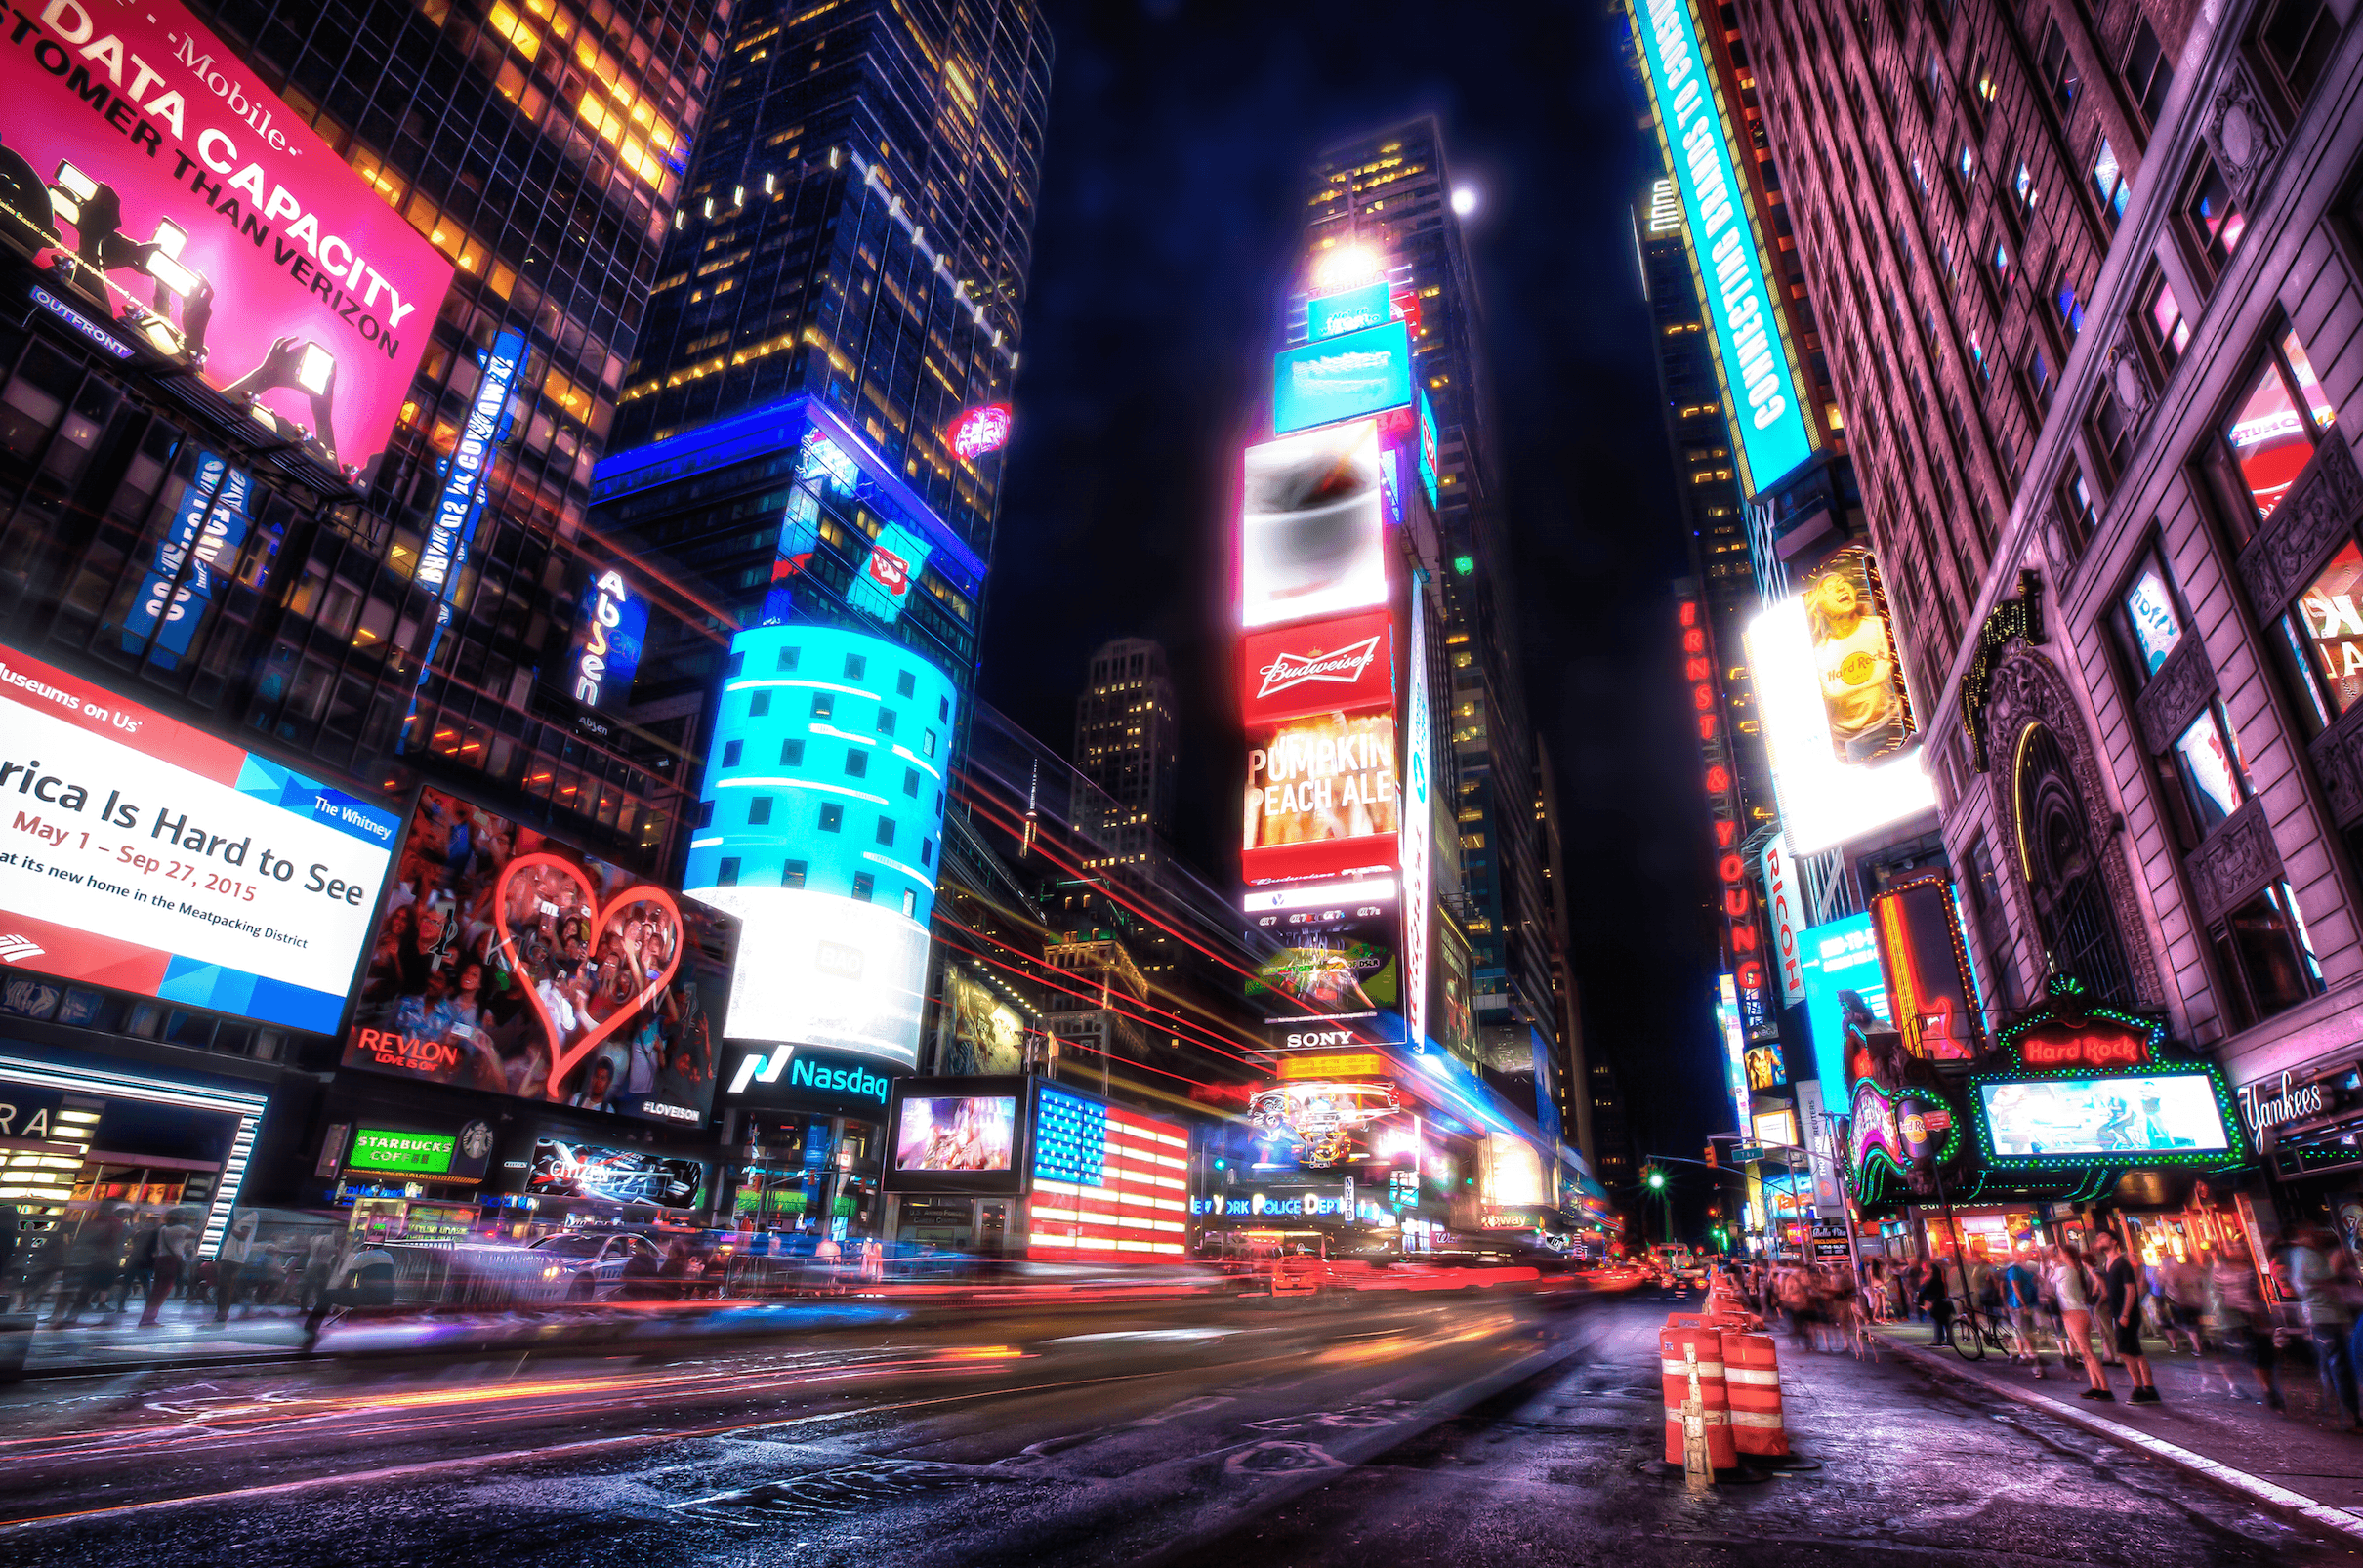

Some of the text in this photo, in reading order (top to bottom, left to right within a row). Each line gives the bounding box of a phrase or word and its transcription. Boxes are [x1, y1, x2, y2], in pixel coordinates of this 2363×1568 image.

[1673, 79, 1703, 131] TO
[40, 0, 416, 329] DATA CAPACITY
[1682, 115, 1734, 240] BRANDS
[175, 148, 270, 248] THAN
[274, 235, 400, 360] VERIZON
[36, 290, 130, 356] OUTFRONT
[1712, 226, 1786, 431] CONNECTING
[575, 570, 627, 707] Absen
[1260, 652, 1373, 683] Budweiser
[1679, 602, 1717, 740] ERNST
[1827, 660, 1855, 682] Hard
[84, 702, 109, 722] on
[112, 711, 139, 734] Us
[1248, 732, 1392, 785] PUMPKIN
[314, 795, 393, 841] The Whitney
[1246, 769, 1393, 817] PEACH ALE
[12, 810, 70, 847] May
[79, 831, 92, 851] 1
[116, 845, 160, 876] Sep
[165, 859, 198, 888] 27,
[204, 870, 258, 904] 2015
[100, 789, 140, 829] Is
[150, 806, 252, 867] Hard
[259, 846, 295, 883] to
[304, 862, 365, 907] See
[0, 851, 309, 951] at its new home in the Meatpacking District
[1715, 820, 1762, 990] YOUNG
[1766, 847, 1800, 992] RICOH
[357, 1027, 458, 1066] REVLON
[375, 1052, 405, 1067] LOVE
[406, 1058, 419, 1070] IS
[1287, 1031, 1354, 1048] SONY
[2028, 1036, 2136, 1062] Hard Rock
[791, 1059, 891, 1105] Nasdaq
[642, 1100, 700, 1122] #LOVEISON
[1808, 1099, 1819, 1135] REUTERS
[2237, 1070, 2322, 1155] Yankees
[357, 1135, 453, 1154] STARBUCKS
[1252, 1193, 1302, 1216] POLICE
[1346, 1177, 1355, 1220] NYPD
